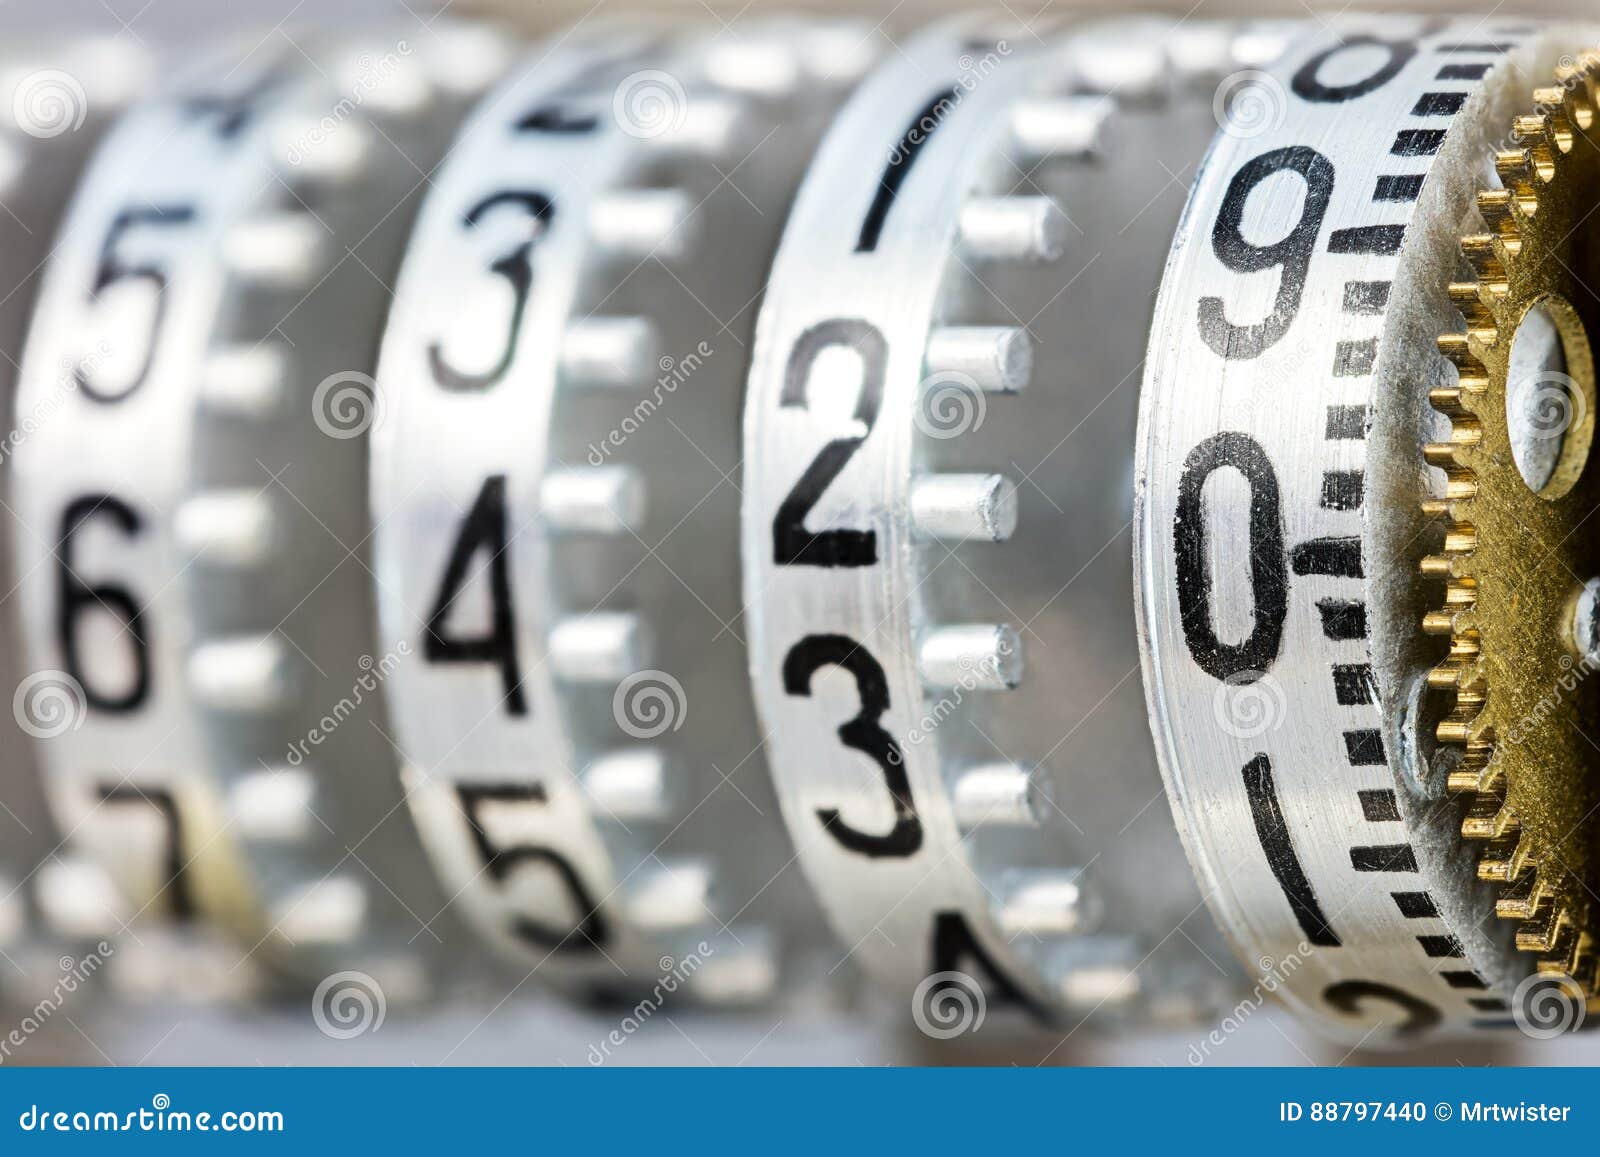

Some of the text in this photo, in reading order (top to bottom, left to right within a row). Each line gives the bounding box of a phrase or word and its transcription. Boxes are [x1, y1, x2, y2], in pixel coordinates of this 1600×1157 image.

[852, 84, 960, 253] 1
[1197, 145, 1336, 361] 9
[73, 203, 194, 405] 5
[427, 190, 556, 392] 3
[773, 318, 890, 567] 2
[56, 493, 152, 714] 6
[422, 473, 529, 717] 4
[1172, 430, 1289, 686] 0
[94, 780, 196, 921] 7
[783, 633, 923, 859] 3
[1241, 751, 1343, 947] 1
[452, 781, 612, 954] 5
